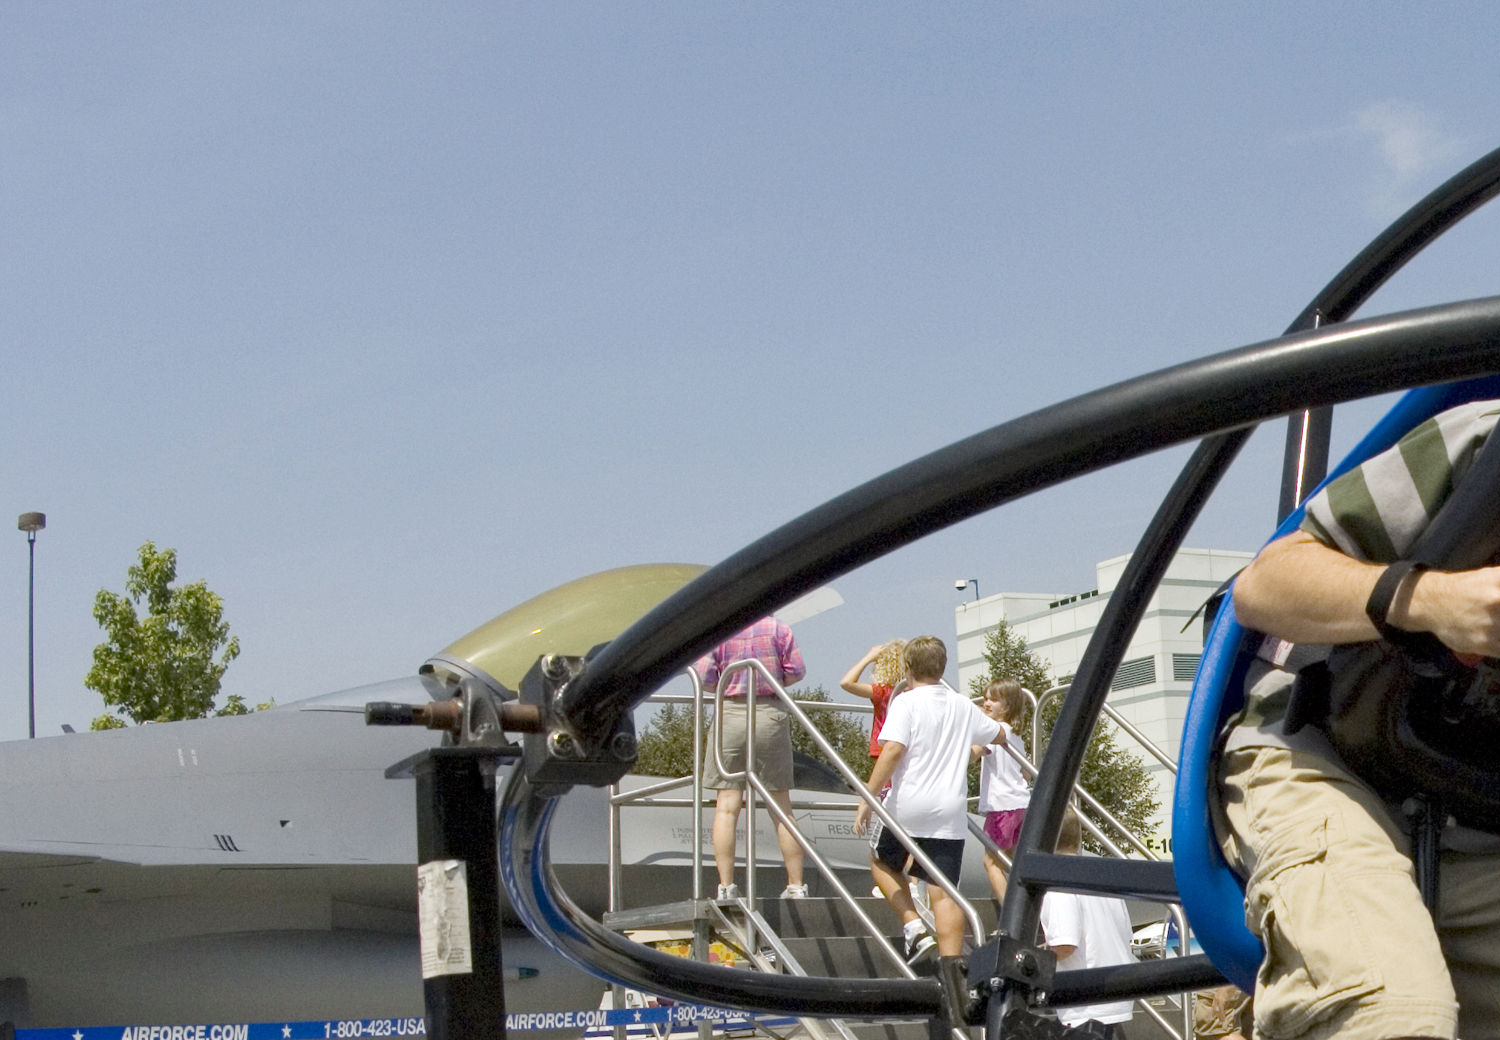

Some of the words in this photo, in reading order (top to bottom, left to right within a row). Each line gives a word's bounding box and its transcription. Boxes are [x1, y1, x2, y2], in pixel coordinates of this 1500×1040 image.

[827, 824, 873, 836] RESE
[323, 1018, 426, 1040] 1-800-423-USA
[506, 1010, 607, 1030] AIRFORCE.COM
